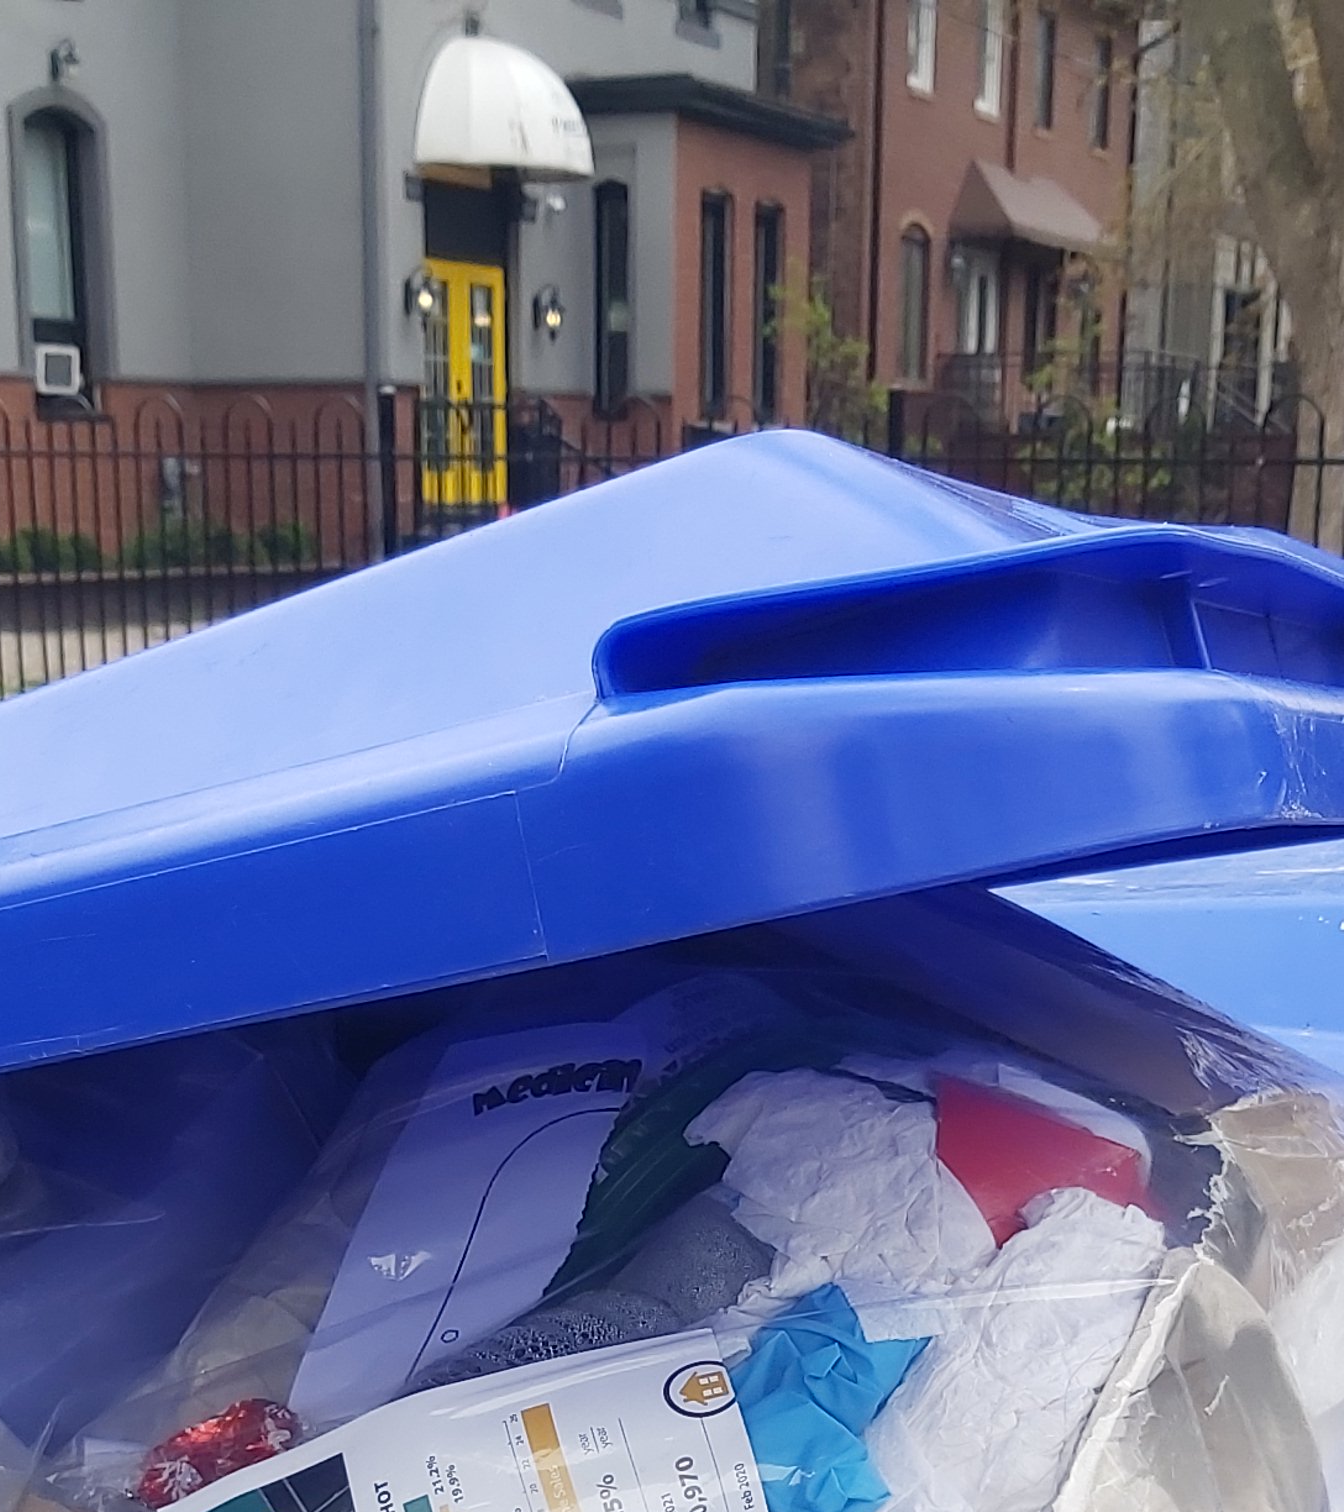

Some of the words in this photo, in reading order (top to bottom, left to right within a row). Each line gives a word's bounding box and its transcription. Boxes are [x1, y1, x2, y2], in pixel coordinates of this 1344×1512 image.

[577, 1430, 594, 1455] year
[595, 1425, 613, 1448] year
[424, 1454, 445, 1495] 21.2%
[443, 1463, 465, 1503] 19.9%
[545, 1463, 566, 1498] Sales
[732, 1462, 750, 1489] 2020
[740, 1489, 755, 1510] Feb
